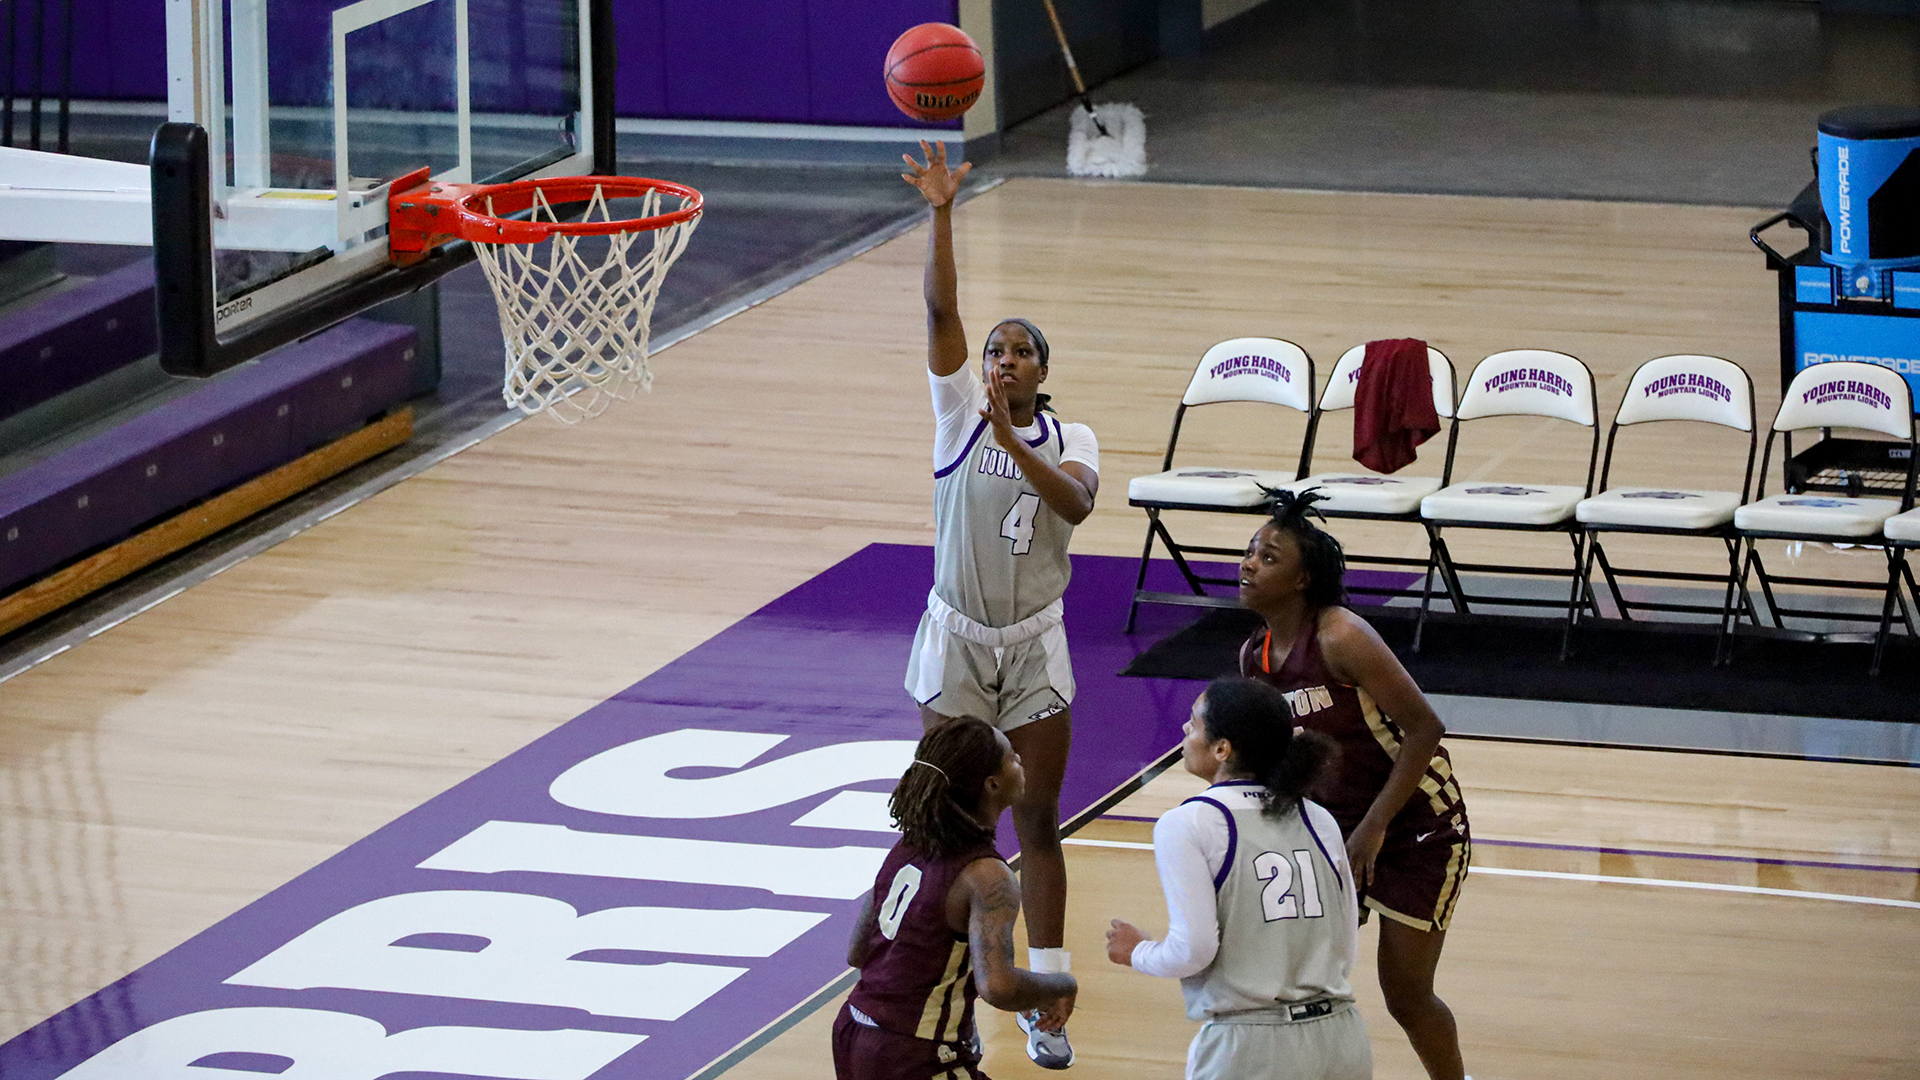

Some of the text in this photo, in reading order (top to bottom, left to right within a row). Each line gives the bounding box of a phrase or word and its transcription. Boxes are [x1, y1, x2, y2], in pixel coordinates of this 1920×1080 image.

[916, 89, 980, 108] Wilson
[1838, 146, 1851, 254] POWERADE
[1210, 355, 1291, 383] YOUNG HARRIS
[1223, 368, 1279, 382] MOUNTAIN LIONS
[1484, 368, 1573, 397] YOUNG HARRIS
[1498, 381, 1560, 396] MOUNTAIN LIONS
[1643, 373, 1731, 402] YOUNG HARRIS
[1658, 386, 1719, 401] MOUNTAIN LIONS
[1802, 380, 1892, 410] YOUNG HARRIS
[1816, 393, 1878, 409] MOUNTAIN LIONS
[1000, 491, 1040, 555] 4
[1252, 849, 1324, 923] 21
[878, 863, 923, 941] 0
